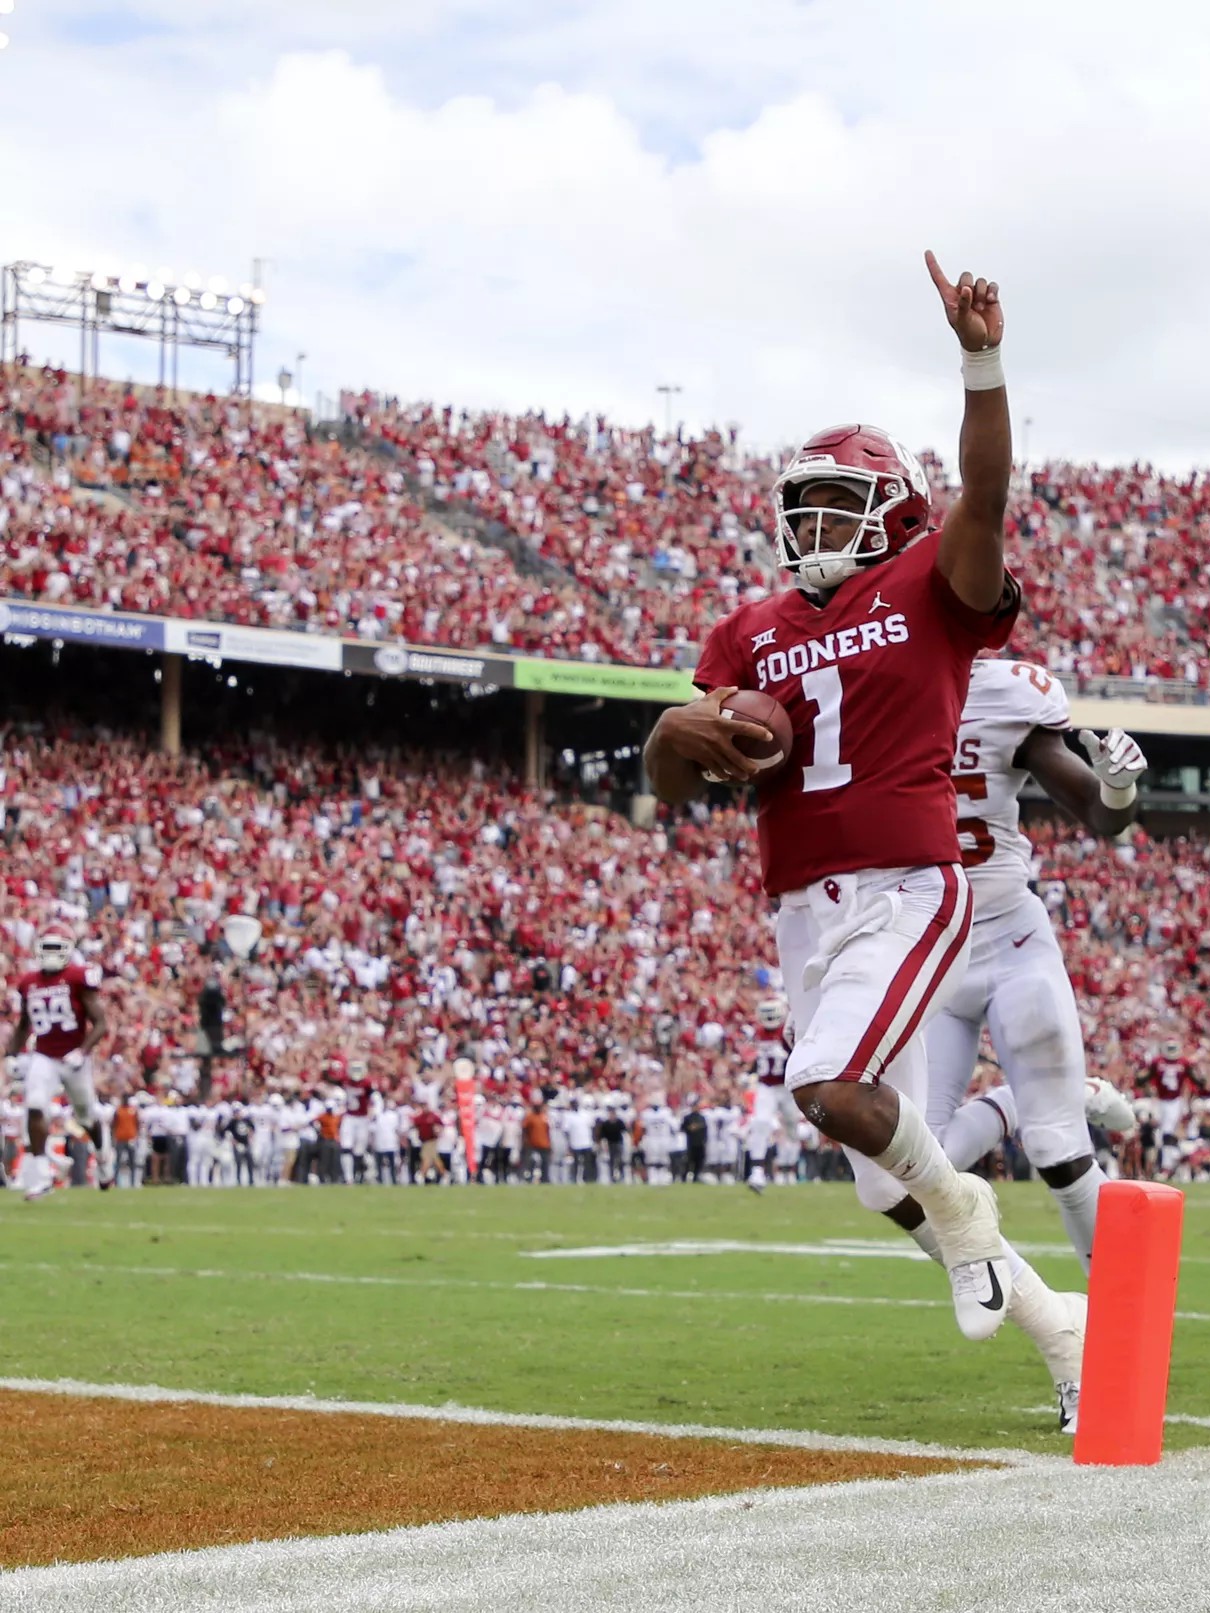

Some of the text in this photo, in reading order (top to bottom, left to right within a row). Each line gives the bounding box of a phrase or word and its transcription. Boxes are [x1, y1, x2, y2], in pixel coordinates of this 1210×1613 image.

[756, 613, 909, 690] SOONERS
[1011, 661, 1053, 696] 2
[802, 664, 853, 792] 1
